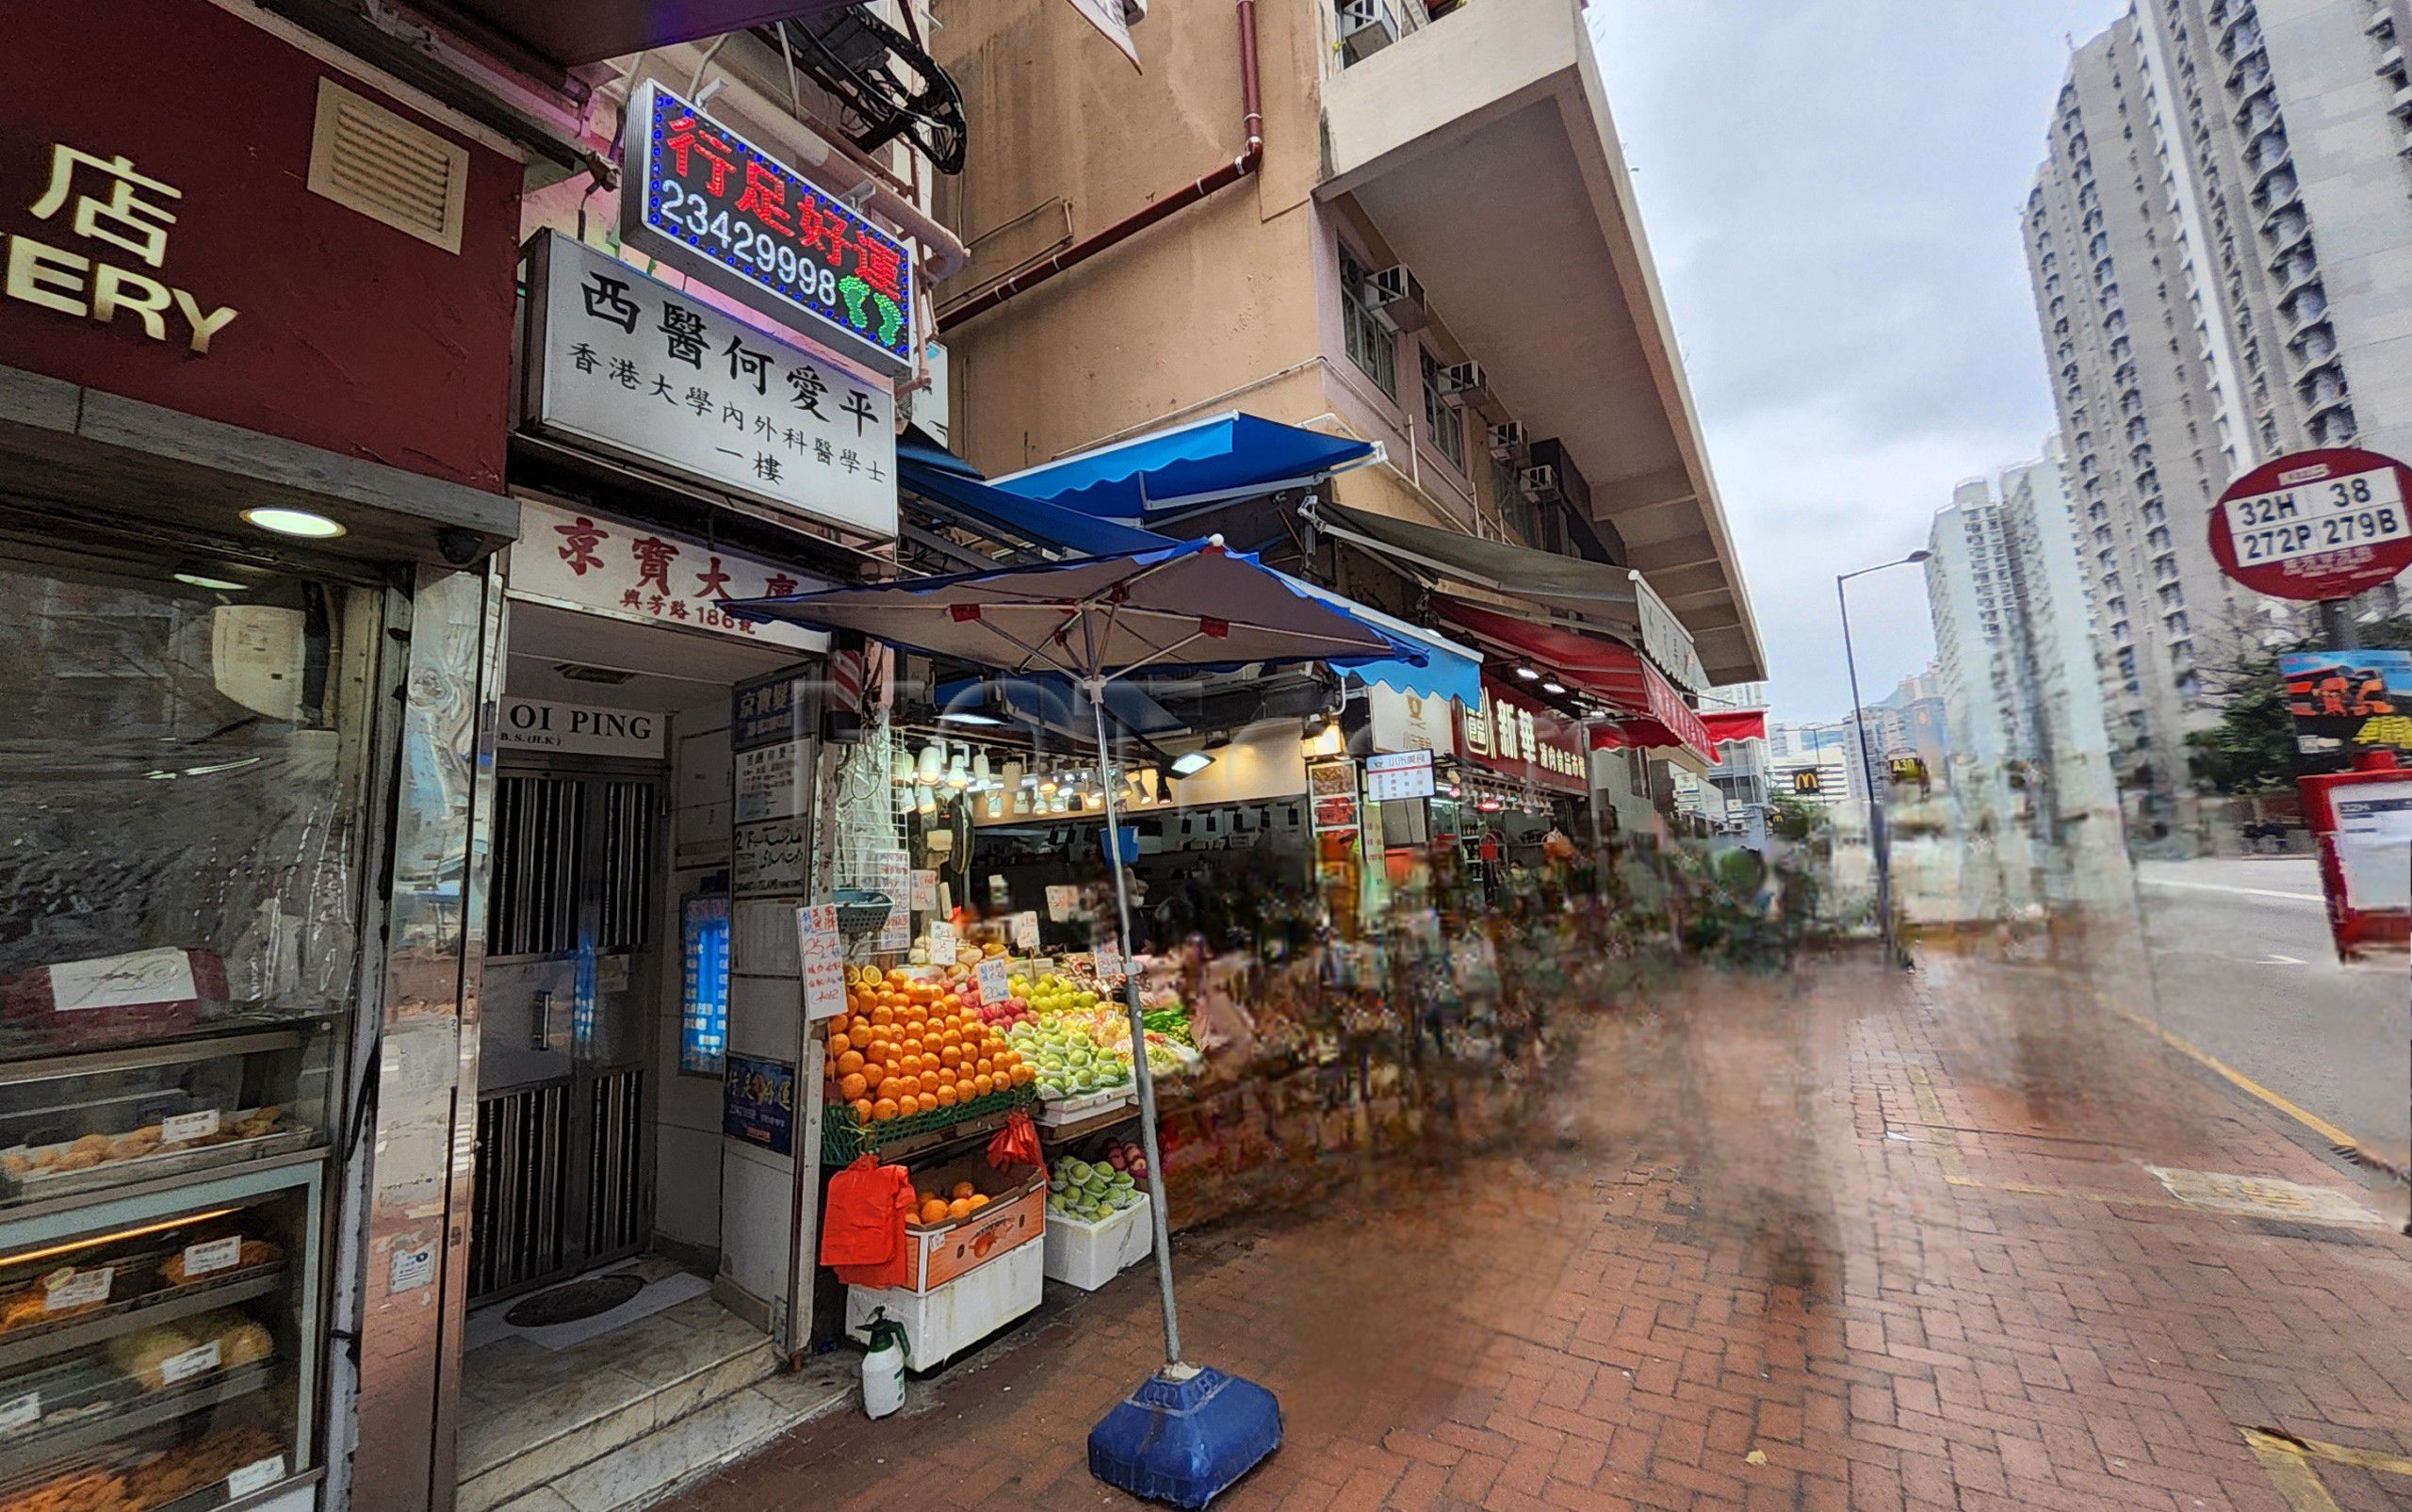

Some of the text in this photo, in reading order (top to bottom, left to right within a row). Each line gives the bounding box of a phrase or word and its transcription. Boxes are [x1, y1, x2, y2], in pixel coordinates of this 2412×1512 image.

[29, 143, 183, 268] 店
[660, 180, 837, 308] 23429998
[665, 113, 902, 301] 行足好運
[0, 232, 240, 354] ERY
[580, 270, 879, 438] 西醫何愛平
[566, 341, 887, 484] 香港大學內外科醫學士
[715, 442, 785, 485] 一樓
[2238, 478, 2372, 527] 32H 38
[2242, 508, 2399, 561] 272P 279B
[510, 705, 652, 740] OI PING
[1496, 698, 1537, 763] 新華
